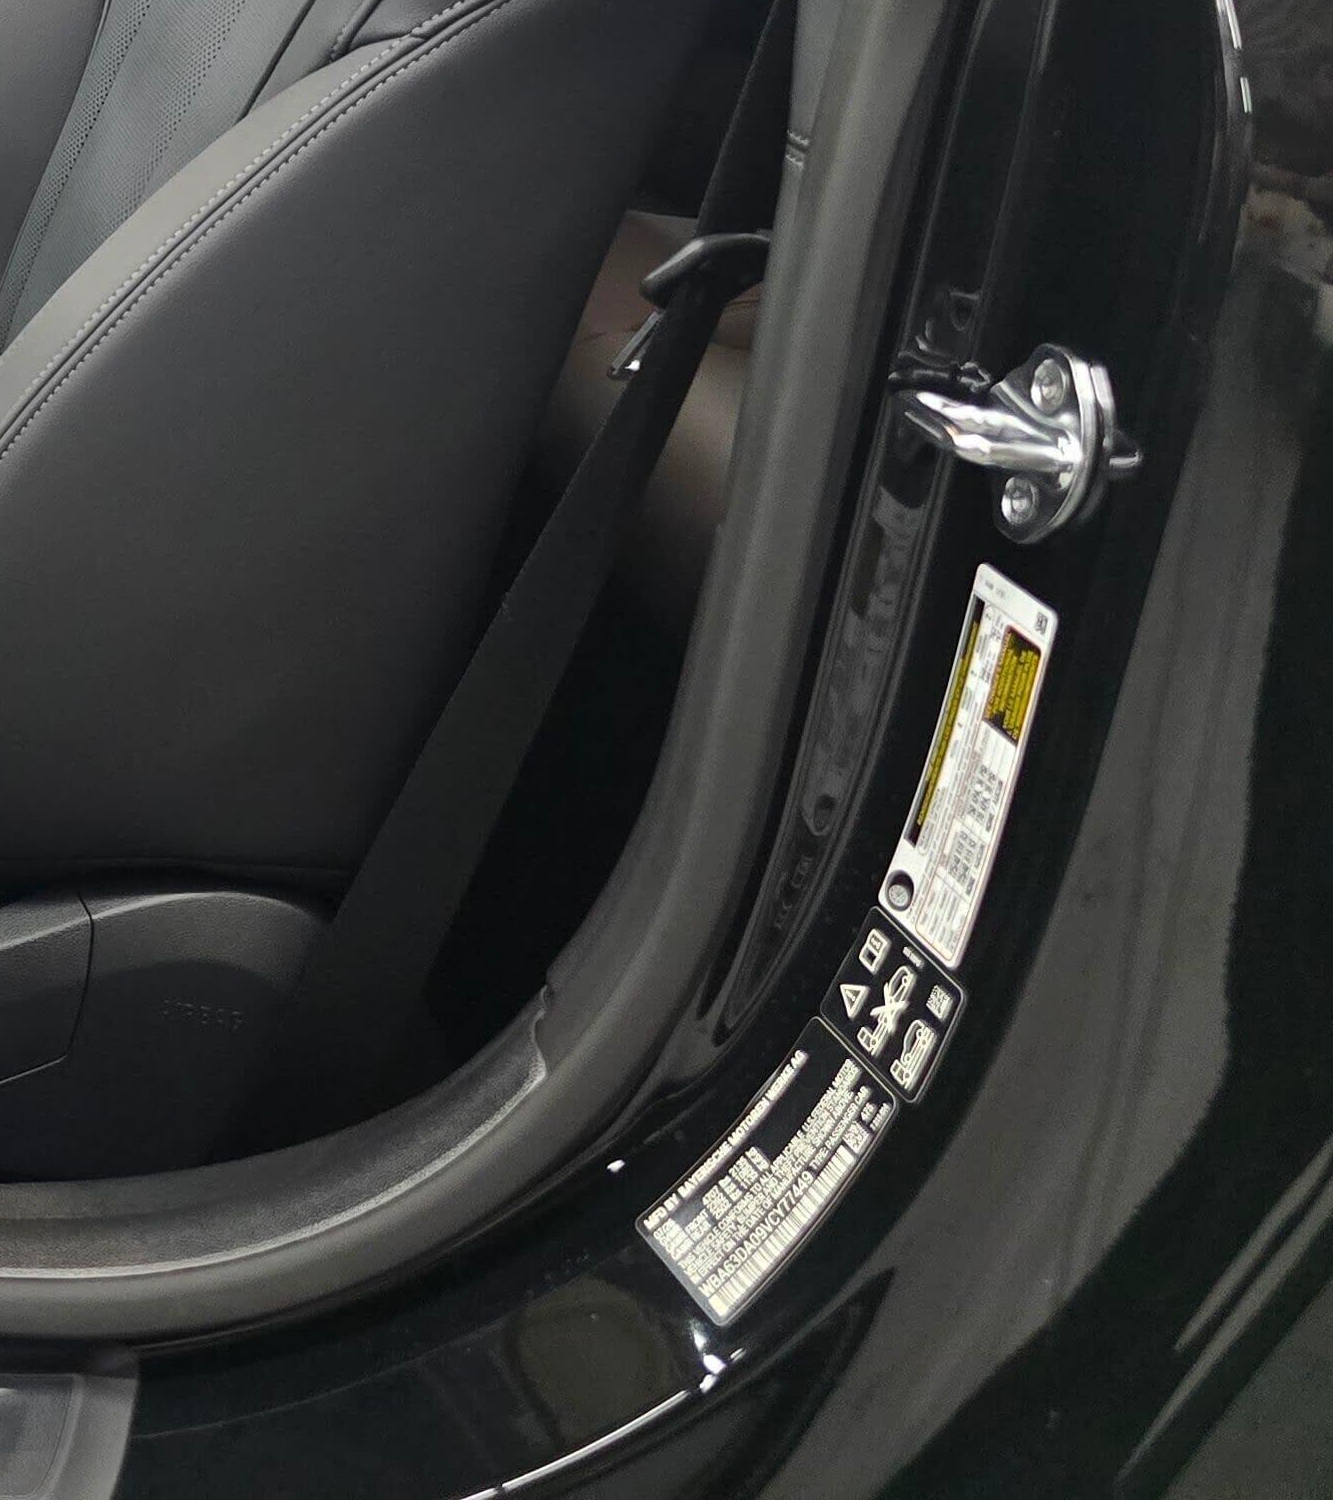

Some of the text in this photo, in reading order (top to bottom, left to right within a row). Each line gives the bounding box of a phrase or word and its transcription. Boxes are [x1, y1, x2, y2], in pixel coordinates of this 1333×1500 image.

[676, 1140, 732, 1199] BAYERISCHE
[726, 1096, 770, 1147] MOTOREN
[764, 1062, 795, 1101] WERKE
[698, 1168, 814, 1300] WBA63DA09VCY77449
[824, 1101, 858, 1150] PASSENGER
[717, 1190, 754, 1231] CONFORMS
